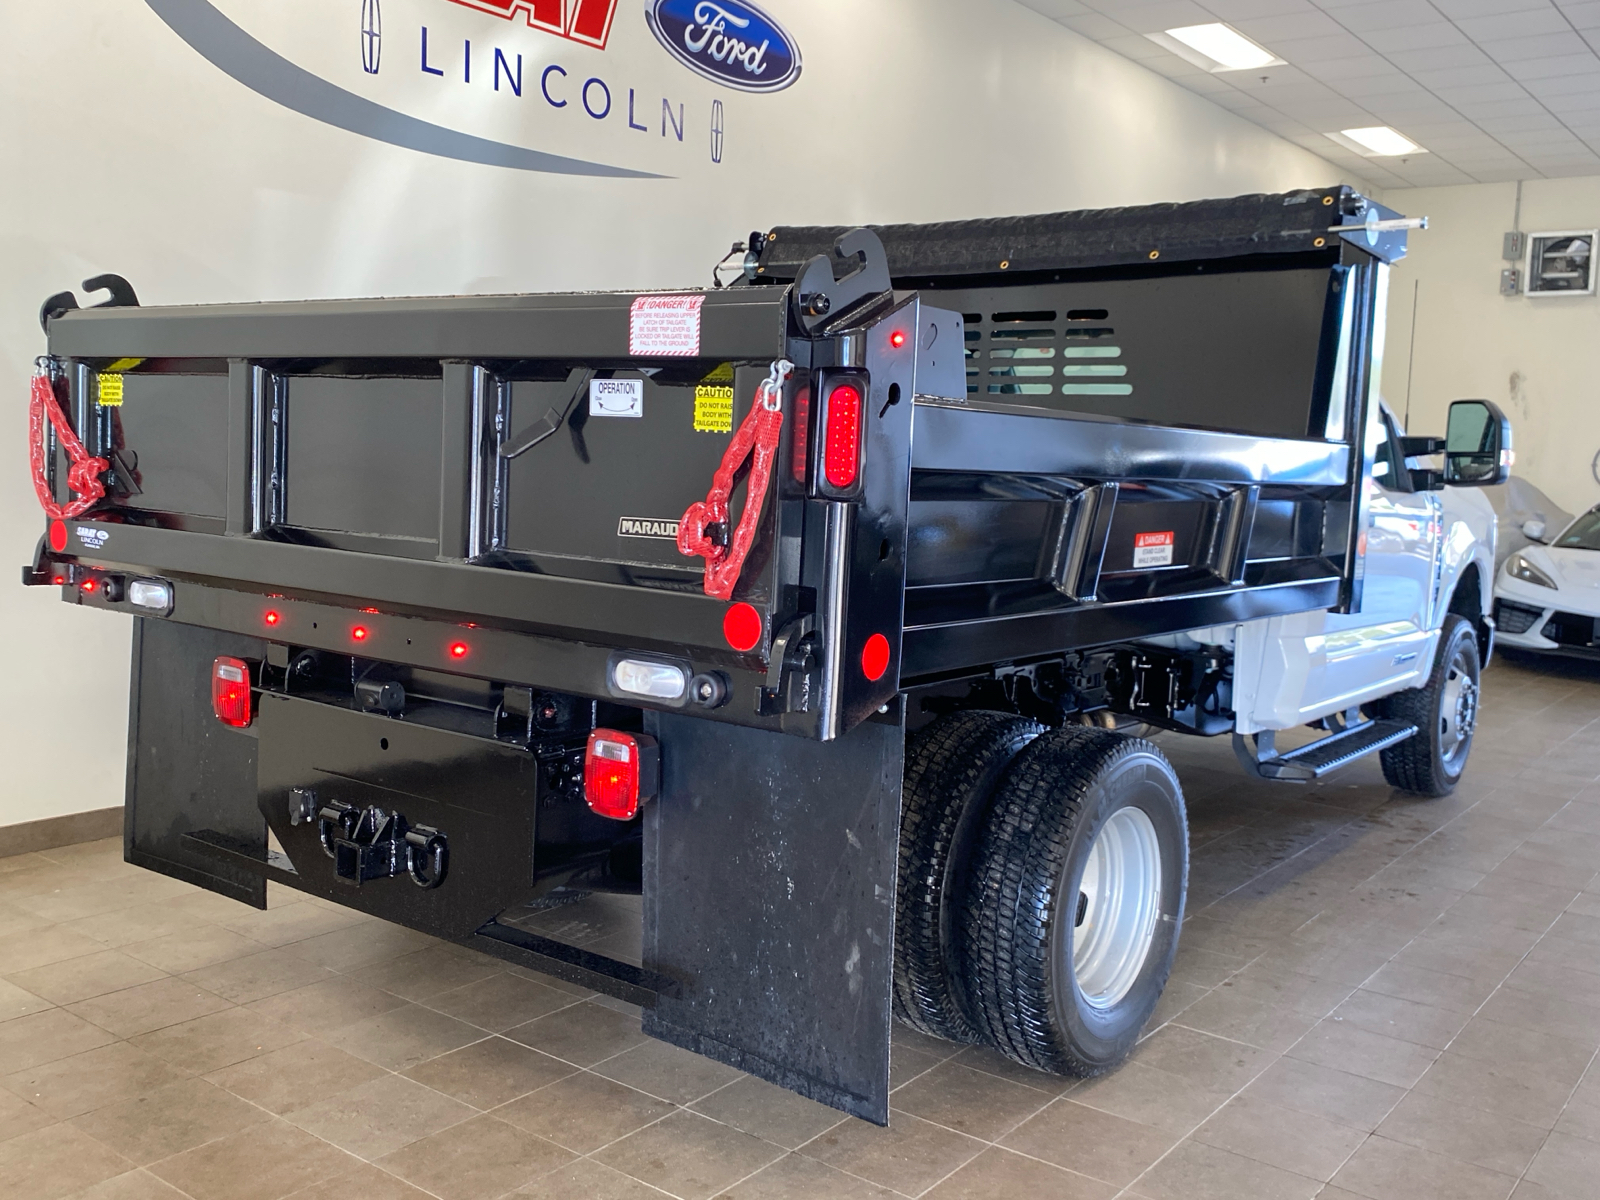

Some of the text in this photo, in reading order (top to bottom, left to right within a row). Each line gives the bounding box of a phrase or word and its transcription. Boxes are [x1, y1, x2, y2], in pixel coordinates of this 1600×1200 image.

[685, 1, 769, 75] Ford
[421, 26, 684, 142] LINCOLN
[598, 382, 635, 394] OPERATION
[698, 388, 732, 398] CAUTIO
[622, 520, 678, 536] MARAUD
[80, 536, 104, 546] LINCOLN
[1145, 535, 1165, 544] DANGER
